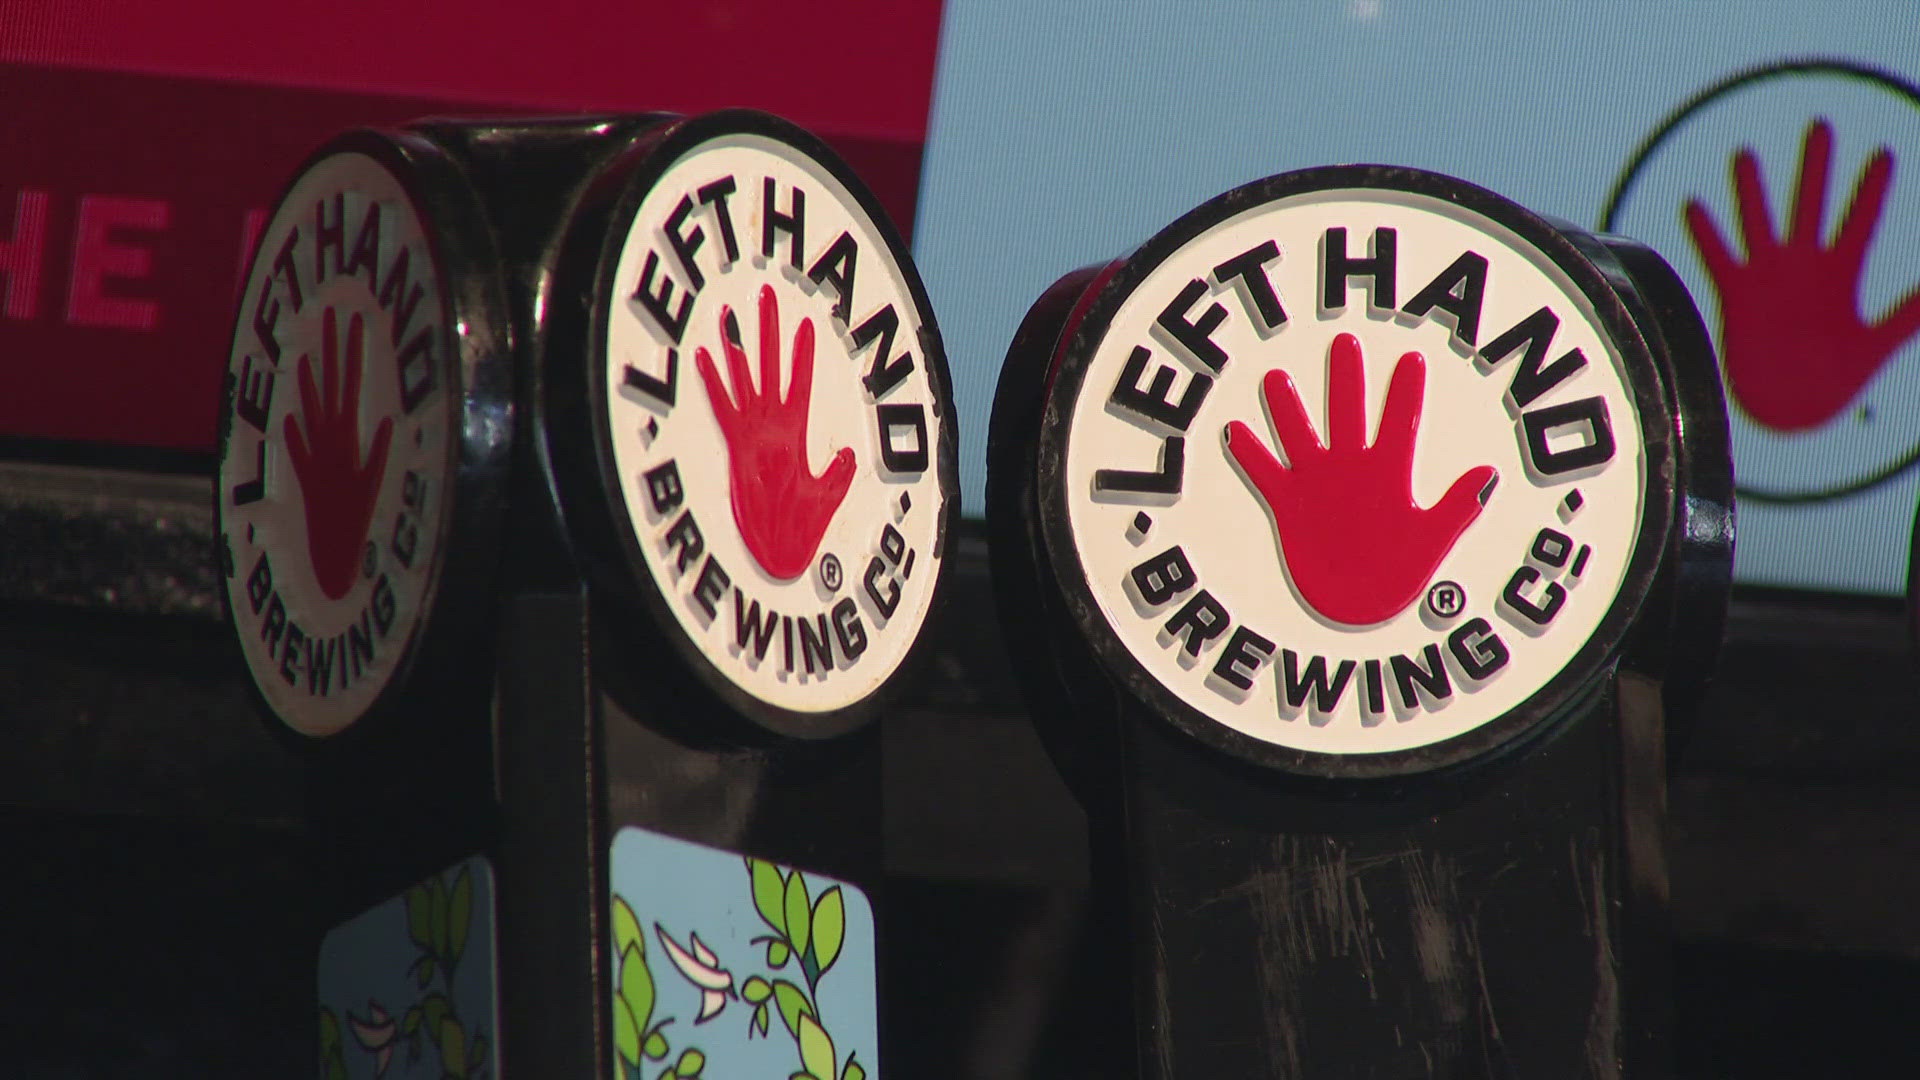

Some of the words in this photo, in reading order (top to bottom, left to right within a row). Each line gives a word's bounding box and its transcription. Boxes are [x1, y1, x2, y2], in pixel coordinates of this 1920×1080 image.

[232, 225, 303, 506] LEFT
[315, 192, 438, 415] HAND
[622, 174, 740, 409] LEFT
[761, 175, 929, 473] HAND
[1094, 239, 1289, 494] LEFT
[1323, 226, 1617, 476] HAND
[247, 551, 396, 697] BREWING
[642, 457, 868, 675] BREWING
[1130, 544, 1511, 715] BREWING
